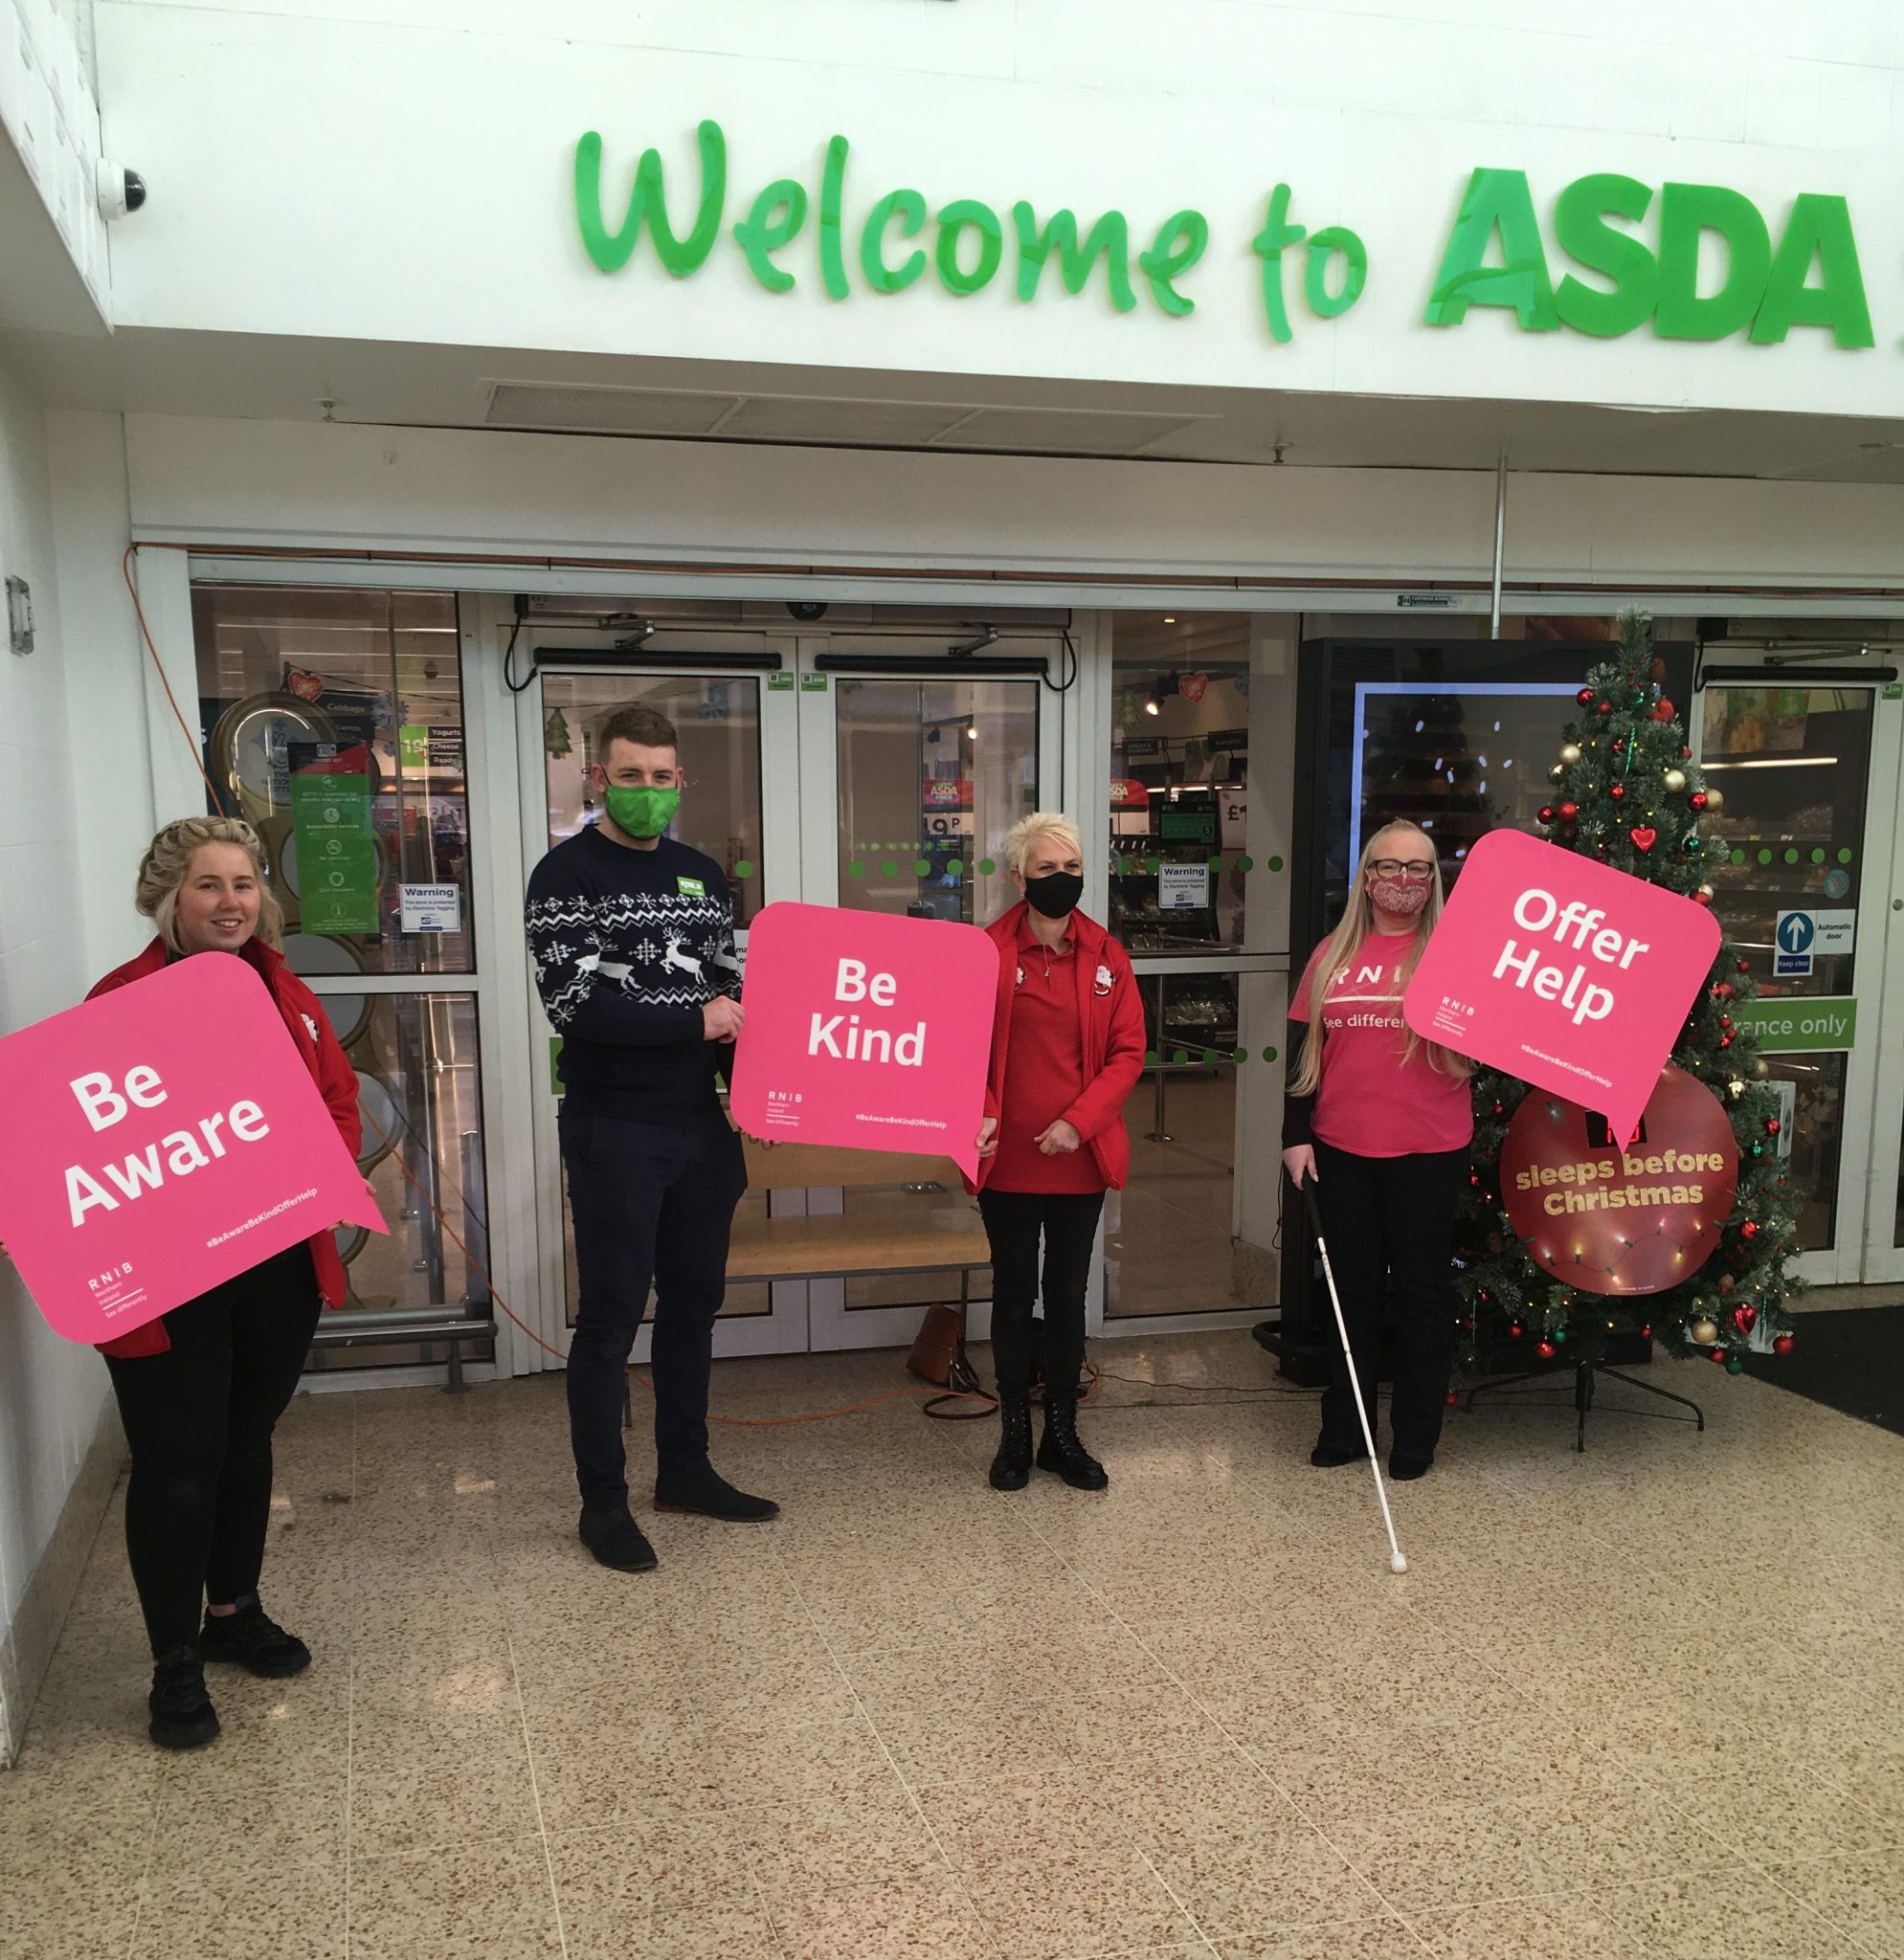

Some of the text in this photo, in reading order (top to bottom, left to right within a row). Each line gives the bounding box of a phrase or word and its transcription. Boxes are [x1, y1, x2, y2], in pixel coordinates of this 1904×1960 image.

[575, 120, 1874, 348] Welcome to ASDA
[930, 786, 958, 795] ASDA
[1164, 868, 1205, 877] Warning
[405, 888, 454, 898] Warning
[1513, 888, 1649, 969] Offer
[836, 958, 897, 1006] Be
[1492, 940, 1614, 1025] Help
[1442, 996, 1475, 1016] RNIB
[1324, 1017, 1343, 1029] See
[1800, 1013, 1848, 1036] only
[808, 1013, 927, 1067] Kind
[1520, 1043, 1613, 1089] #BeAwareBeKindOfferHelp
[70, 1065, 168, 1132] Be
[768, 1091, 802, 1102] RNIB
[856, 1113, 948, 1130] #BeAwareBeKindOfferHelp
[64, 1100, 270, 1229] Aware
[1516, 1149, 1723, 1191] sleeps before
[1543, 1184, 1703, 1216] Christmas
[207, 1187, 318, 1248] #BeAwareBeKindOfferHelp
[87, 1261, 133, 1291] RNIB
[105, 1310, 117, 1319] See
